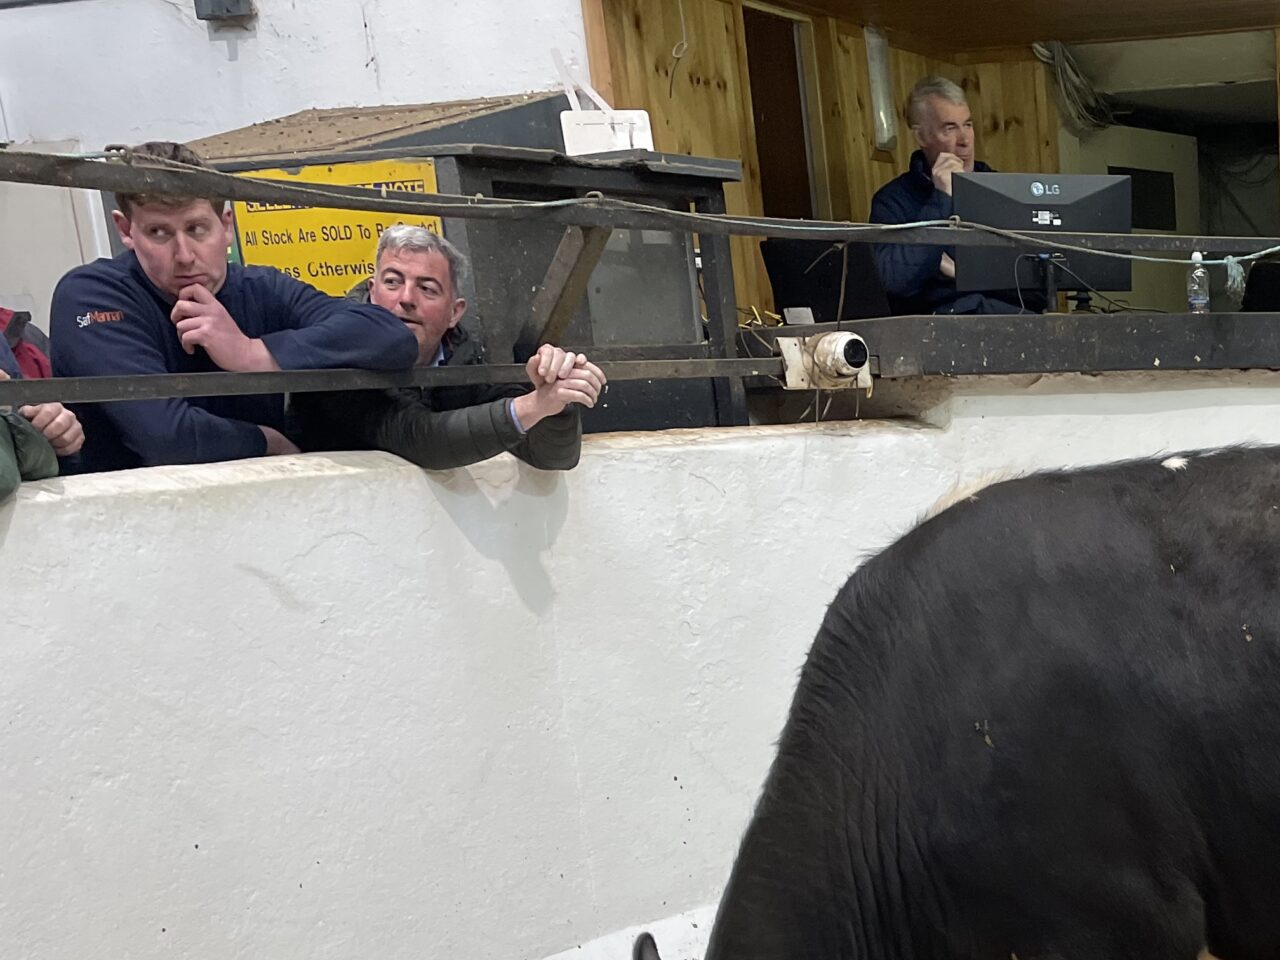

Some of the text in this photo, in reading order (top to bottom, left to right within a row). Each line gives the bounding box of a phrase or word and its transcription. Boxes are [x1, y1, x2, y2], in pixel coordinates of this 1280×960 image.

[1045, 184, 1060, 195] LG
[245, 231, 258, 247] All
[262, 228, 294, 246] Stock
[298, 227, 317, 243] Are
[321, 224, 353, 242] SOLD
[356, 223, 372, 240] To
[307, 259, 376, 278] Otherwis
